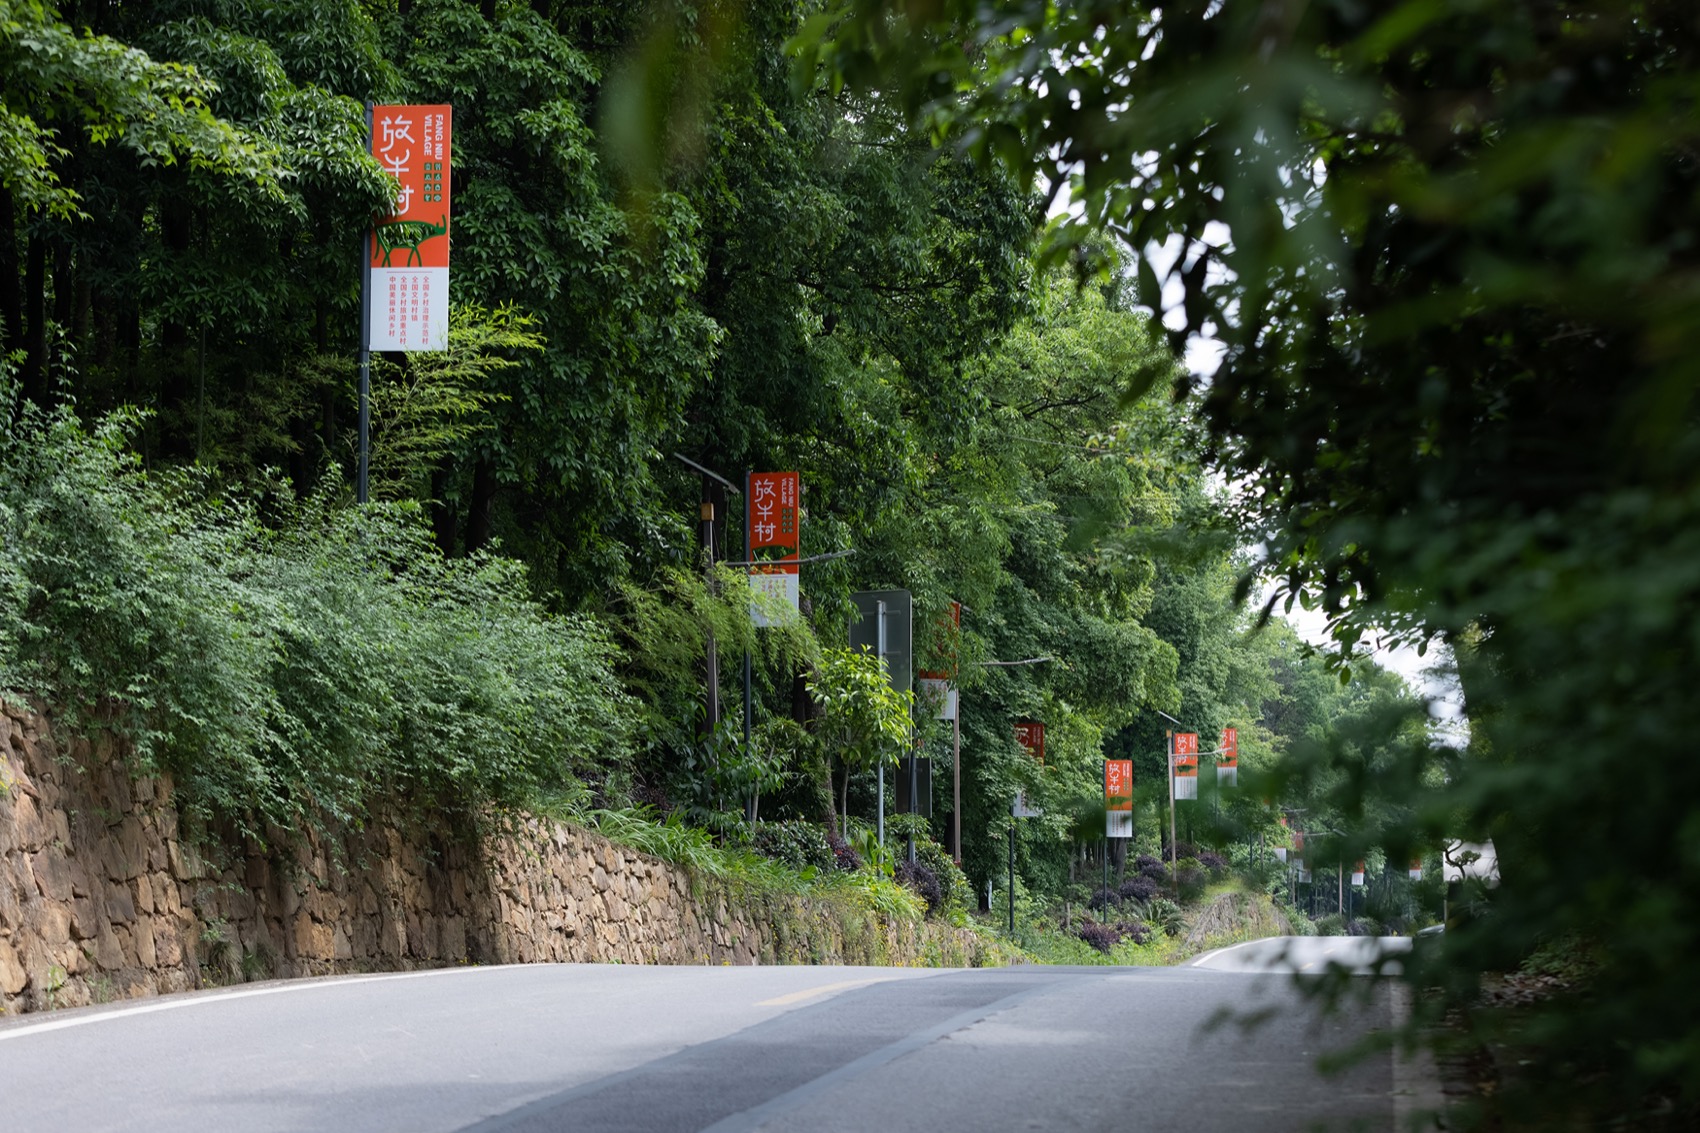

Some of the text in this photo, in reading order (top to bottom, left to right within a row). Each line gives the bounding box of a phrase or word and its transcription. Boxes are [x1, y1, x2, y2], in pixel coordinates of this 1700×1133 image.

[424, 114, 433, 156] VILLAGE
[435, 114, 444, 160] FANG NIU
[388, 275, 397, 337] 中国美丽休闲乡村
[399, 275, 408, 345] 全国乡村旅游重点村
[411, 275, 419, 322] 全国文明村镇
[422, 275, 430, 345] 全国乡村治理示范村
[754, 478, 776, 542] 放牛村
[1108, 763, 1121, 795] 放牛村
